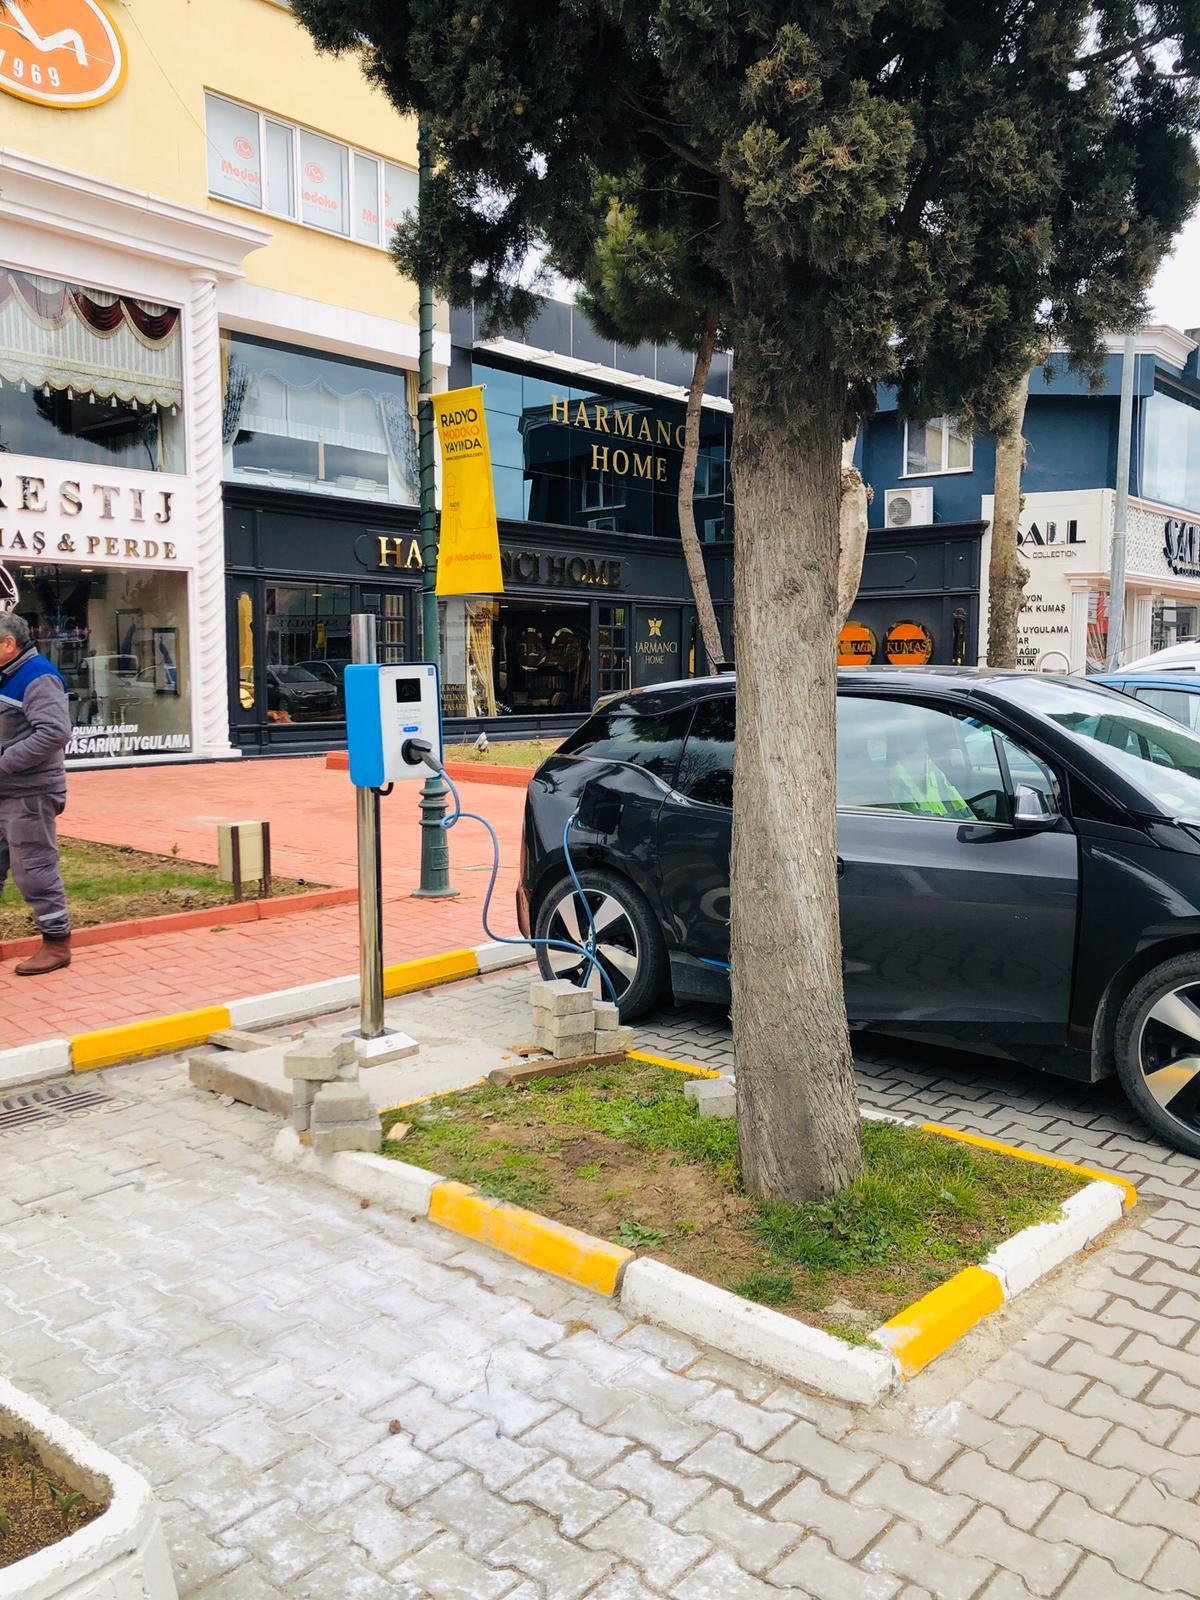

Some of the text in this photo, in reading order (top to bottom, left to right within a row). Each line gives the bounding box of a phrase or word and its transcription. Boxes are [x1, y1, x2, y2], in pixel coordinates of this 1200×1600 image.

[302, 190, 338, 209] odoko
[440, 408, 478, 427] RADYO
[551, 394, 686, 449] HARMANC
[445, 437, 482, 453] YAYINDA
[591, 443, 668, 482] HOME
[0, 528, 177, 560] AŞ & PERDE
[455, 552, 493, 562] Modoko
[1032, 550, 1077, 560] COLLECTION
[546, 555, 622, 587] HOME
[1036, 604, 1066, 614] KUMAŞ
[1023, 626, 1070, 634] UYGULAMA
[645, 655, 665, 664] HOME
[72, 725, 104, 736] DUVAR
[124, 734, 191, 751] UYGULAMA
